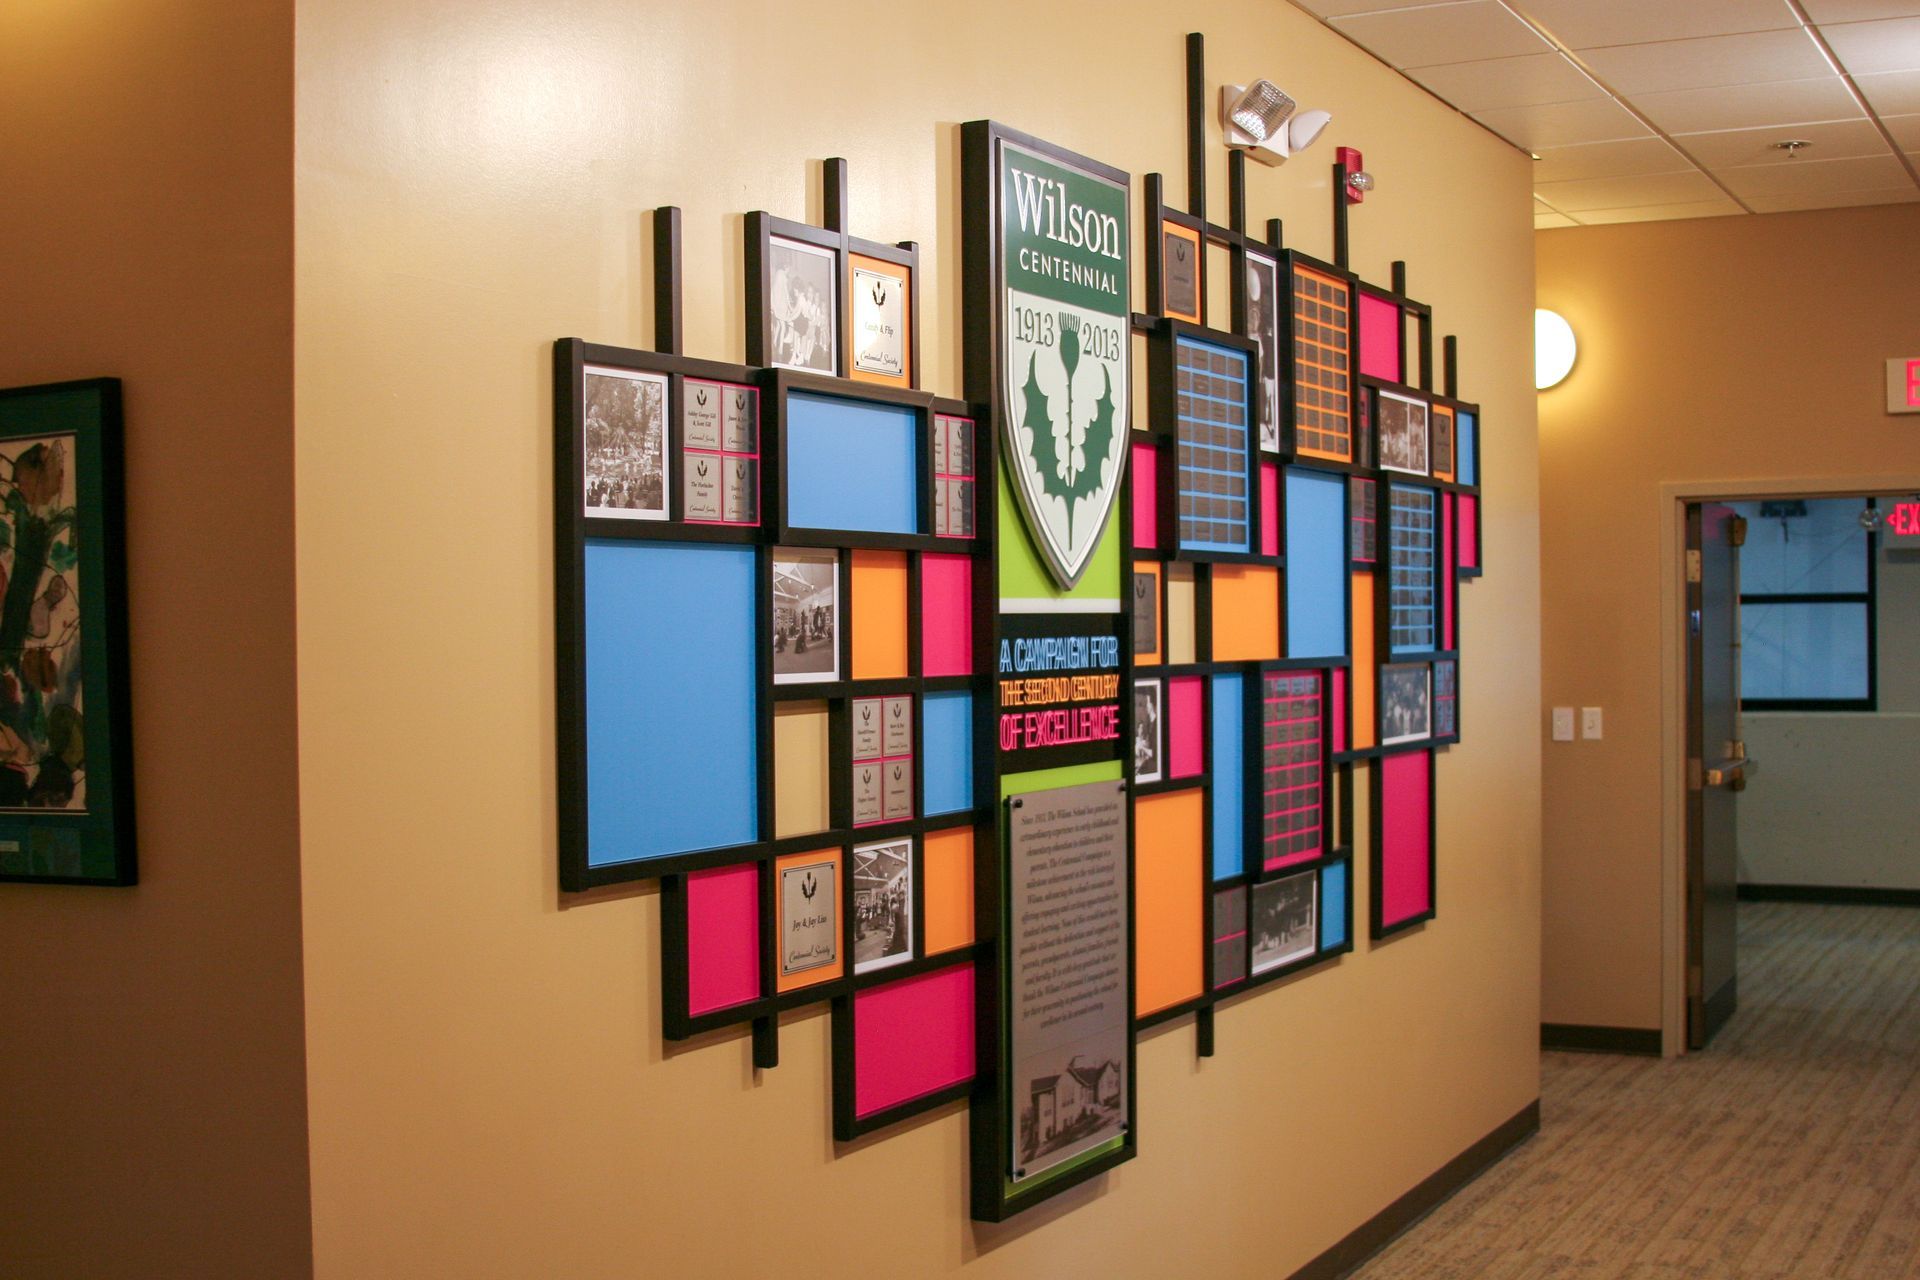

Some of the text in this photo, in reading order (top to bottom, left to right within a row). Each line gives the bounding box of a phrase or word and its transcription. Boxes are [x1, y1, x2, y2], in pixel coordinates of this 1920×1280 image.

[1011, 168, 1121, 260] Wilson
[1019, 248, 1118, 295] CENTENNIAL
[1015, 307, 1120, 362] 1913 2013
[1000, 636, 1119, 672] A CAMPAIGN FOR
[1000, 674, 1119, 706] THE SECOND CENTURY
[1001, 705, 1120, 751] OF EXCELLENCE
